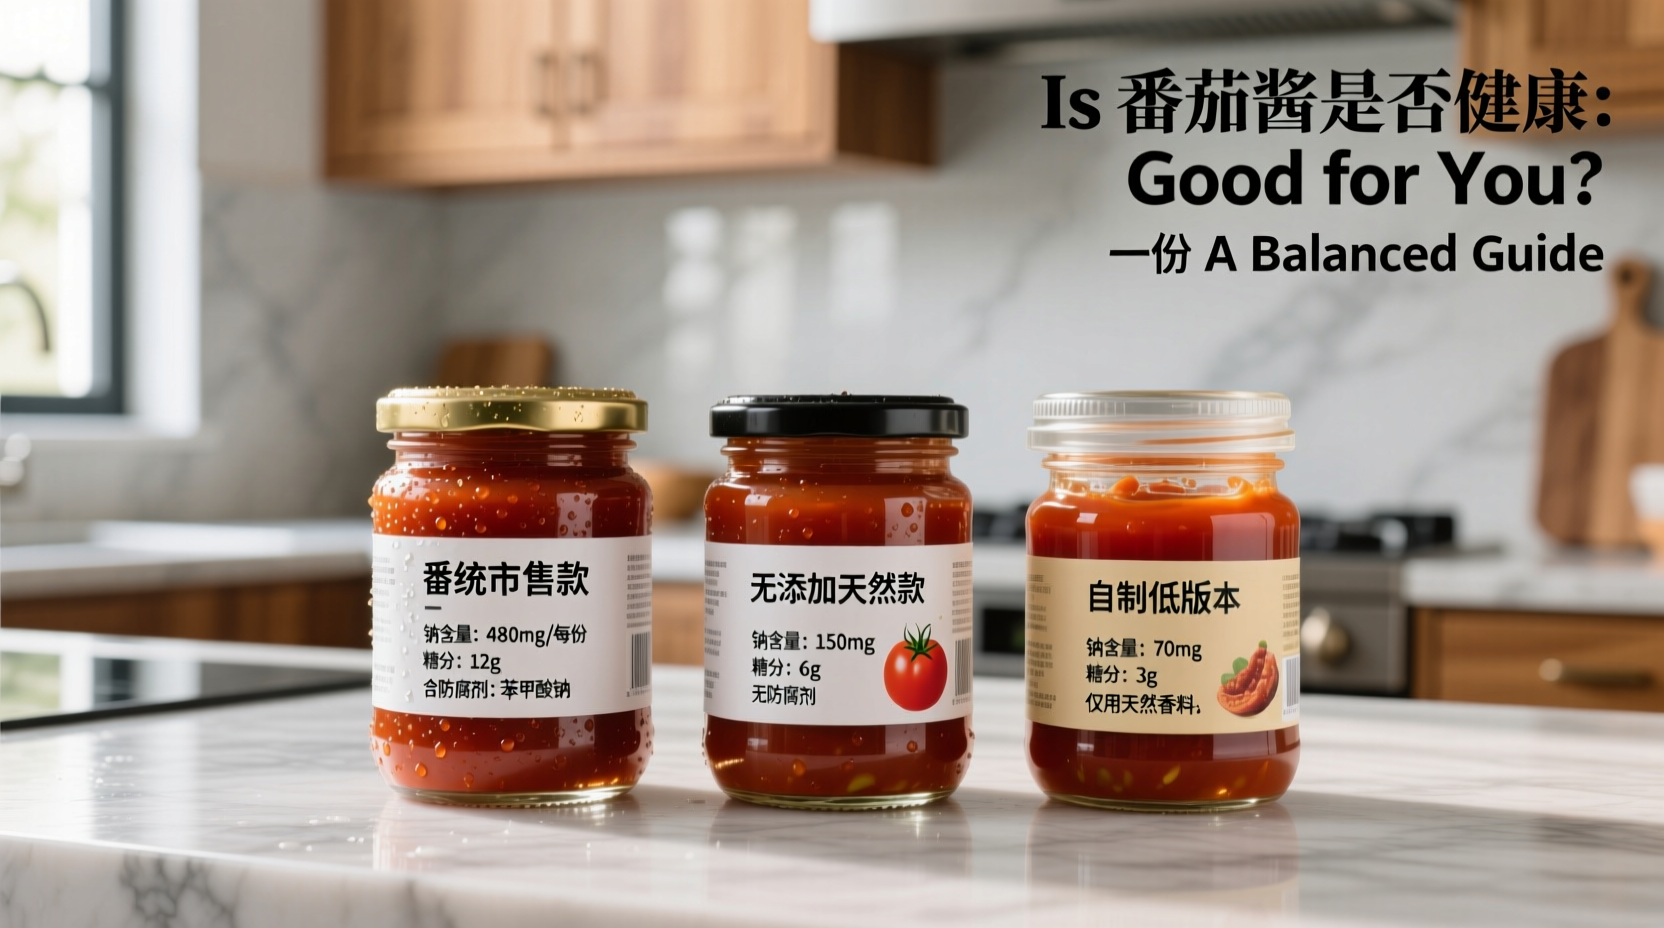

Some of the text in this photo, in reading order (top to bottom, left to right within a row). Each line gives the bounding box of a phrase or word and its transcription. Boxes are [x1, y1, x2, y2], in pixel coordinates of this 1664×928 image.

[423, 560, 590, 597] 番统市售款
[750, 571, 925, 605] 无添加天然款
[1089, 579, 1241, 615] 自制低版本
[751, 683, 816, 706] 无防腐剂
